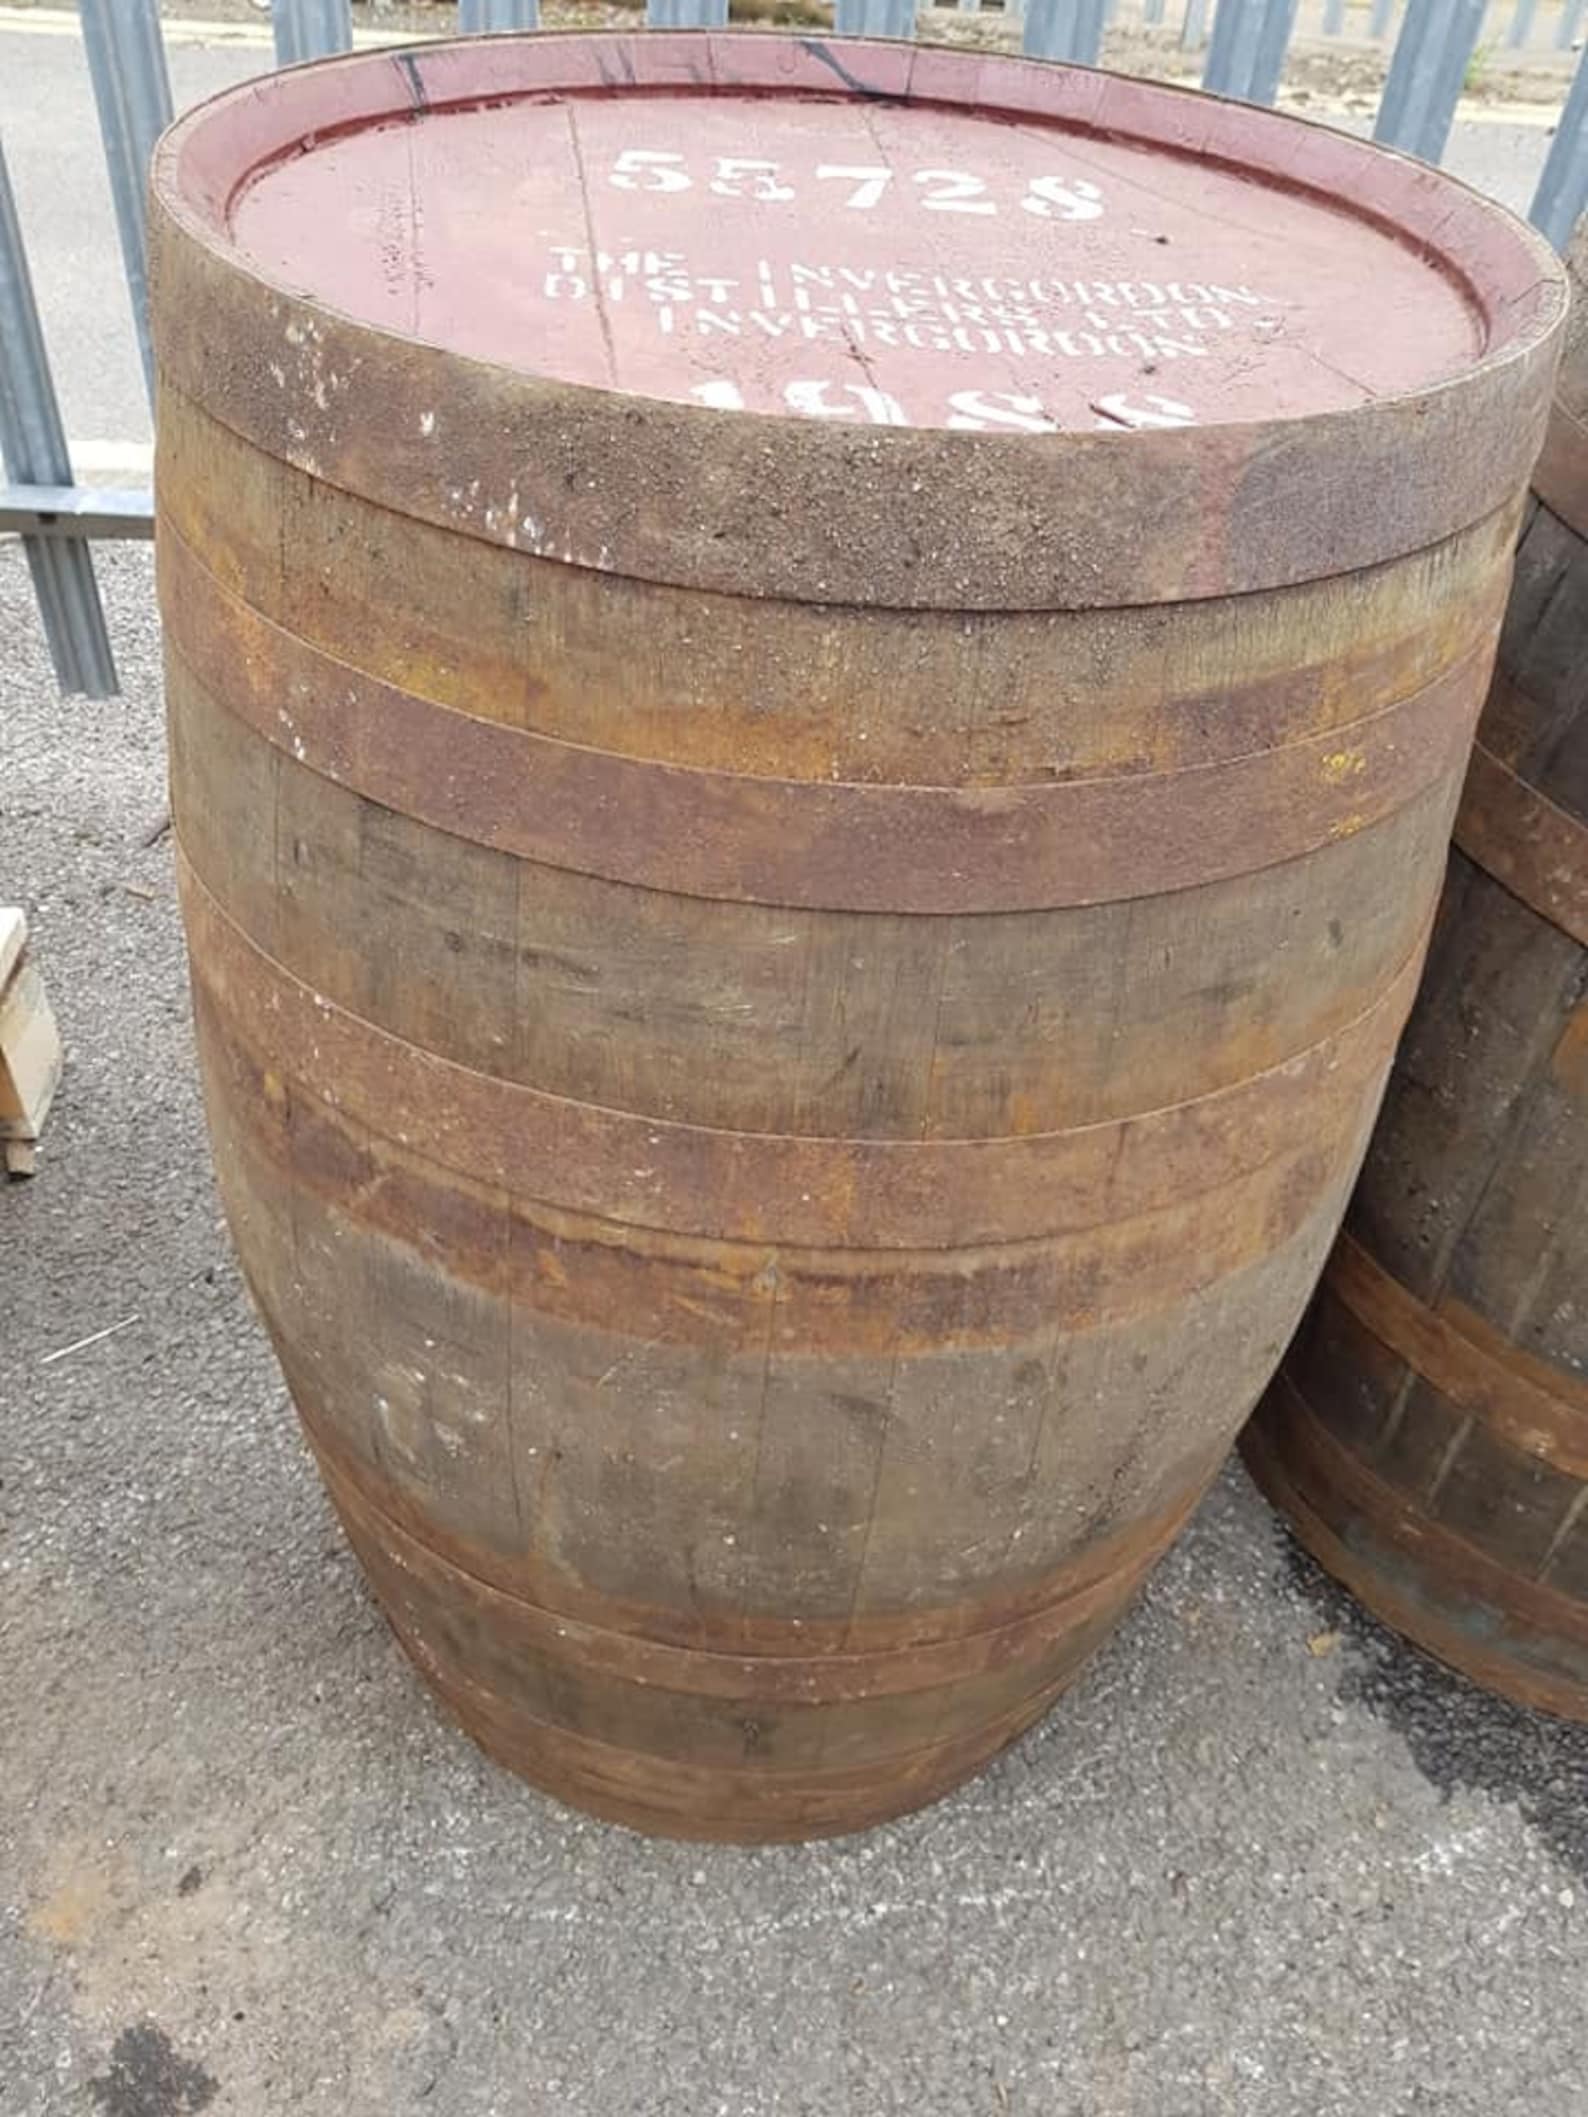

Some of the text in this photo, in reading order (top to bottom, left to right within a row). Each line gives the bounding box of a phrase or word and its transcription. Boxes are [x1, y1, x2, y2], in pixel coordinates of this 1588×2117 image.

[608, 150, 1104, 221] 55728
[544, 272, 1040, 328] DISTILLERS
[549, 246, 1263, 304] THE INVERGORDON
[660, 305, 1207, 358] INVERGORDON
